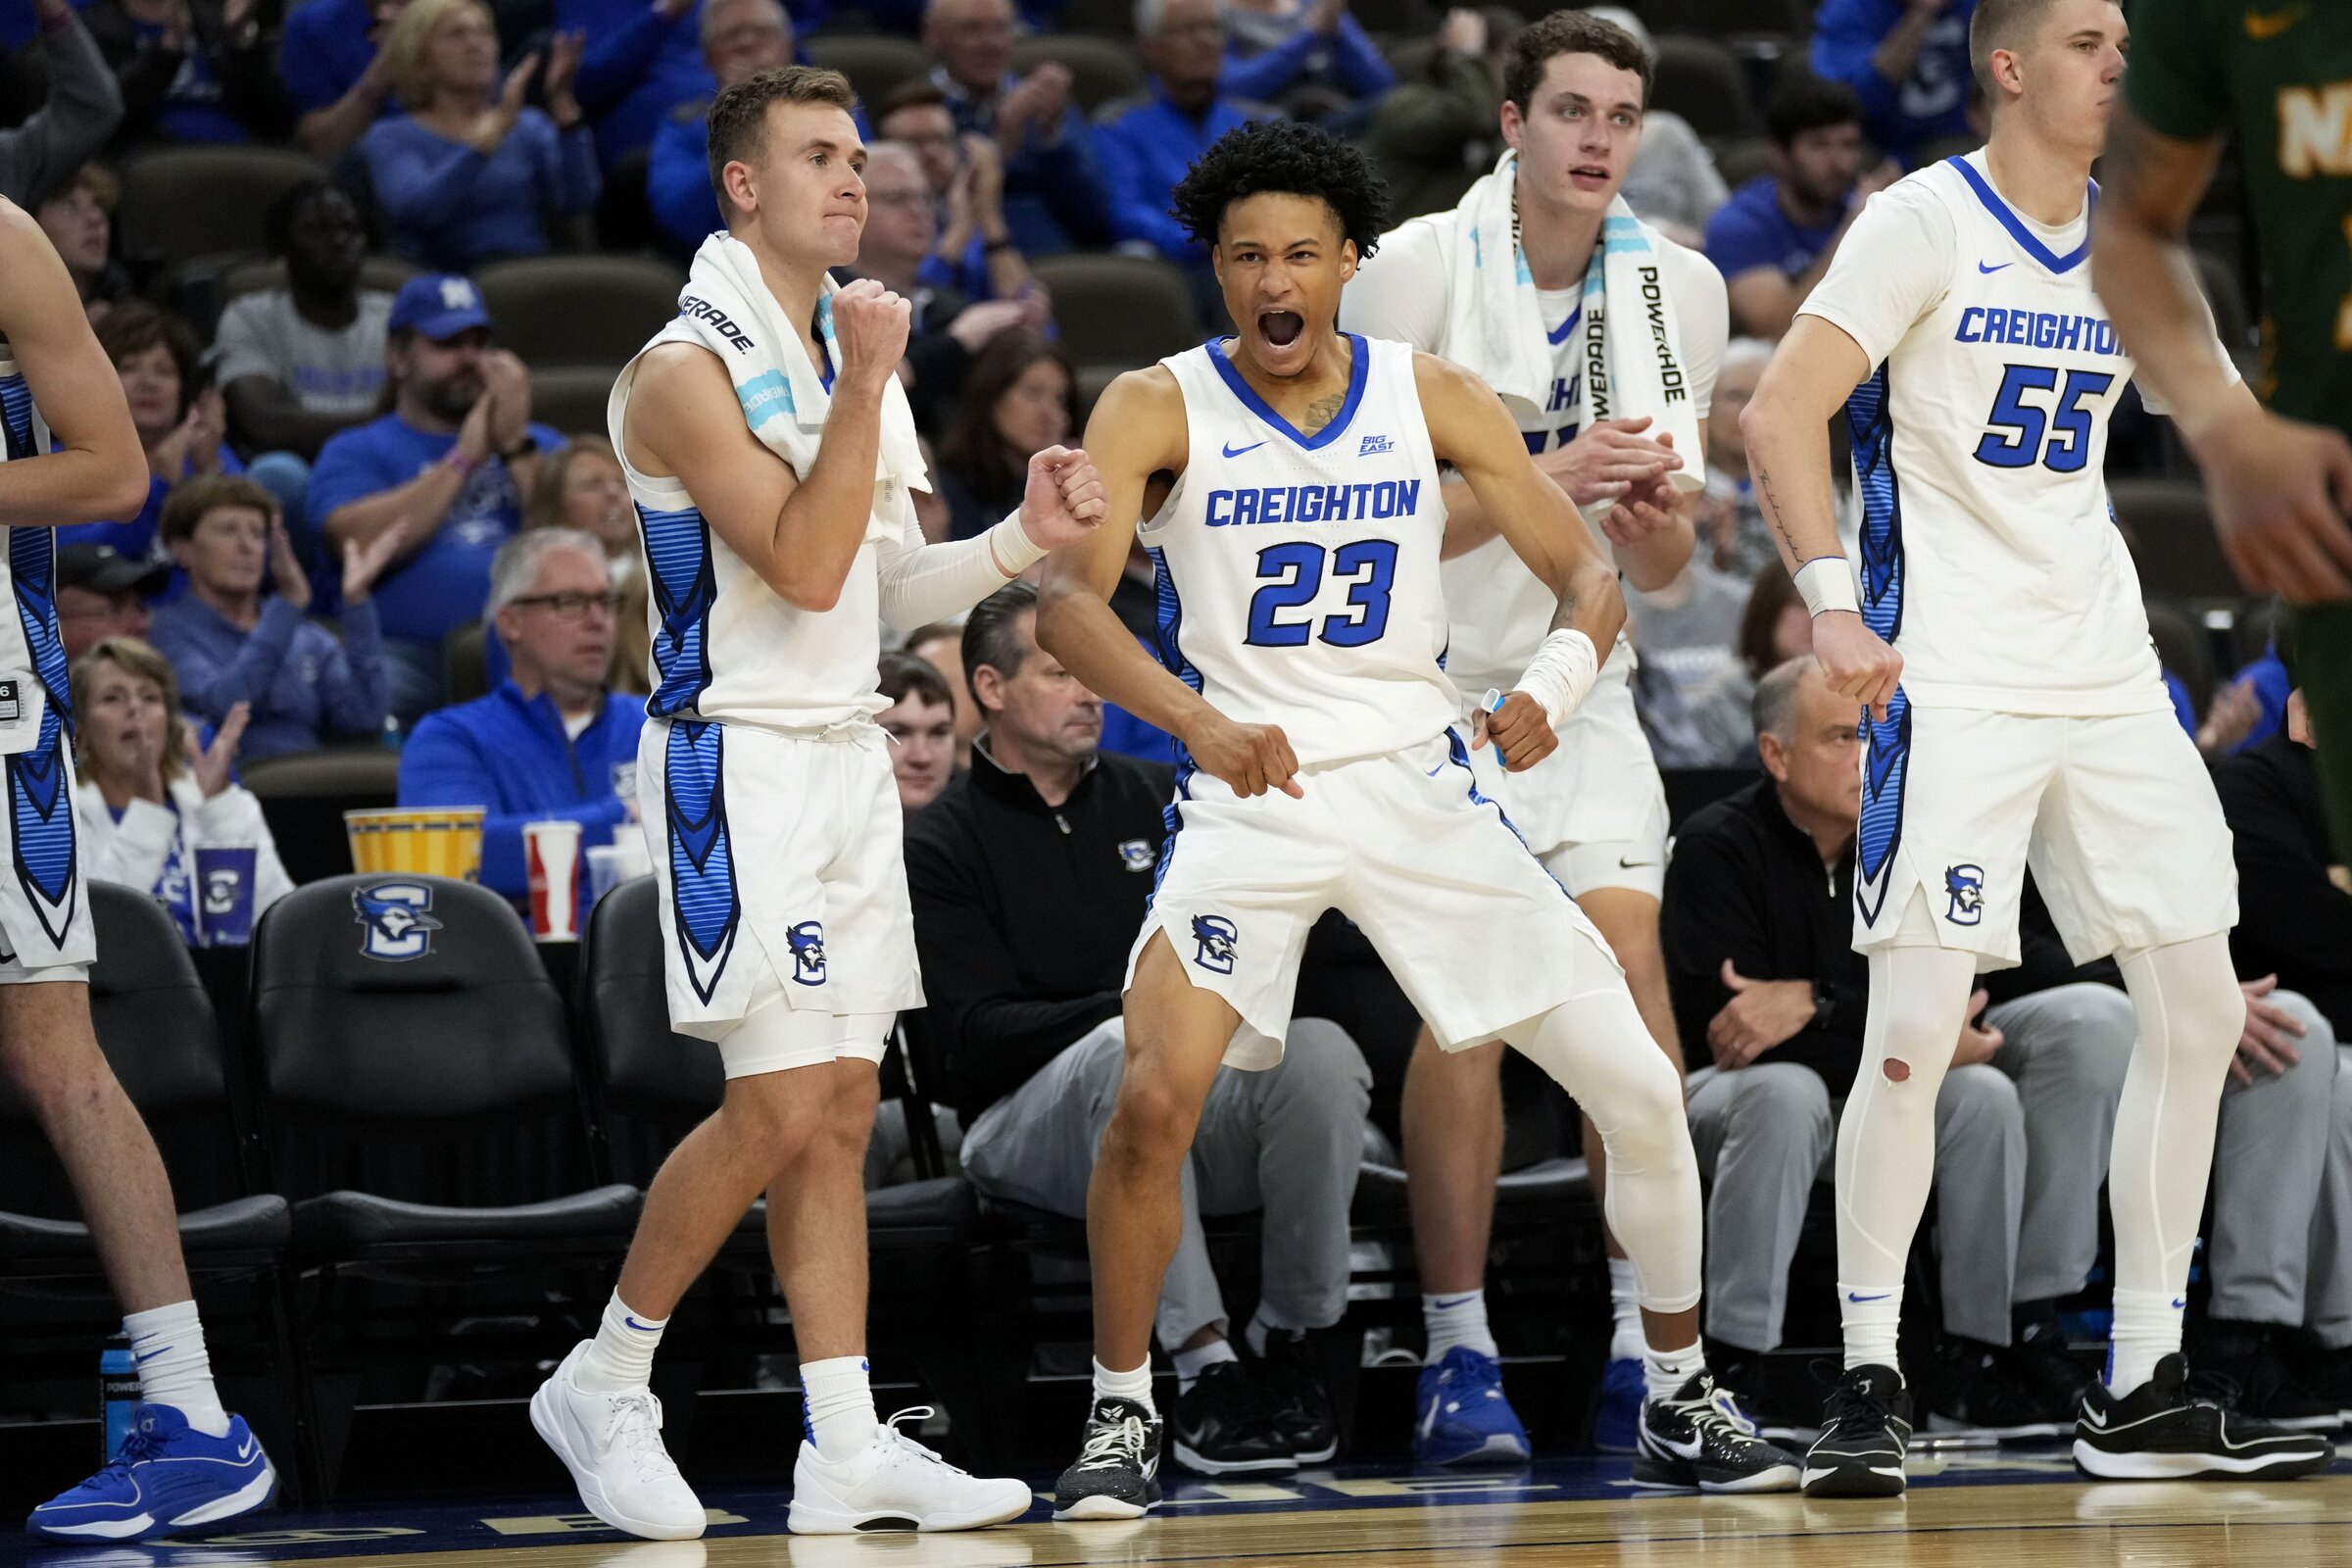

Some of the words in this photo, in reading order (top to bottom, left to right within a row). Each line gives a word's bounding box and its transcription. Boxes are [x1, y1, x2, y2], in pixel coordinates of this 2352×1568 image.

[1587, 309, 1610, 422] WERADE
[1359, 441, 1395, 453] EAST
[1362, 435, 1387, 445] BIG
[1972, 364, 2115, 473] 55
[1204, 479, 1421, 527] CREIGHTON
[1242, 538, 1399, 648] 23
